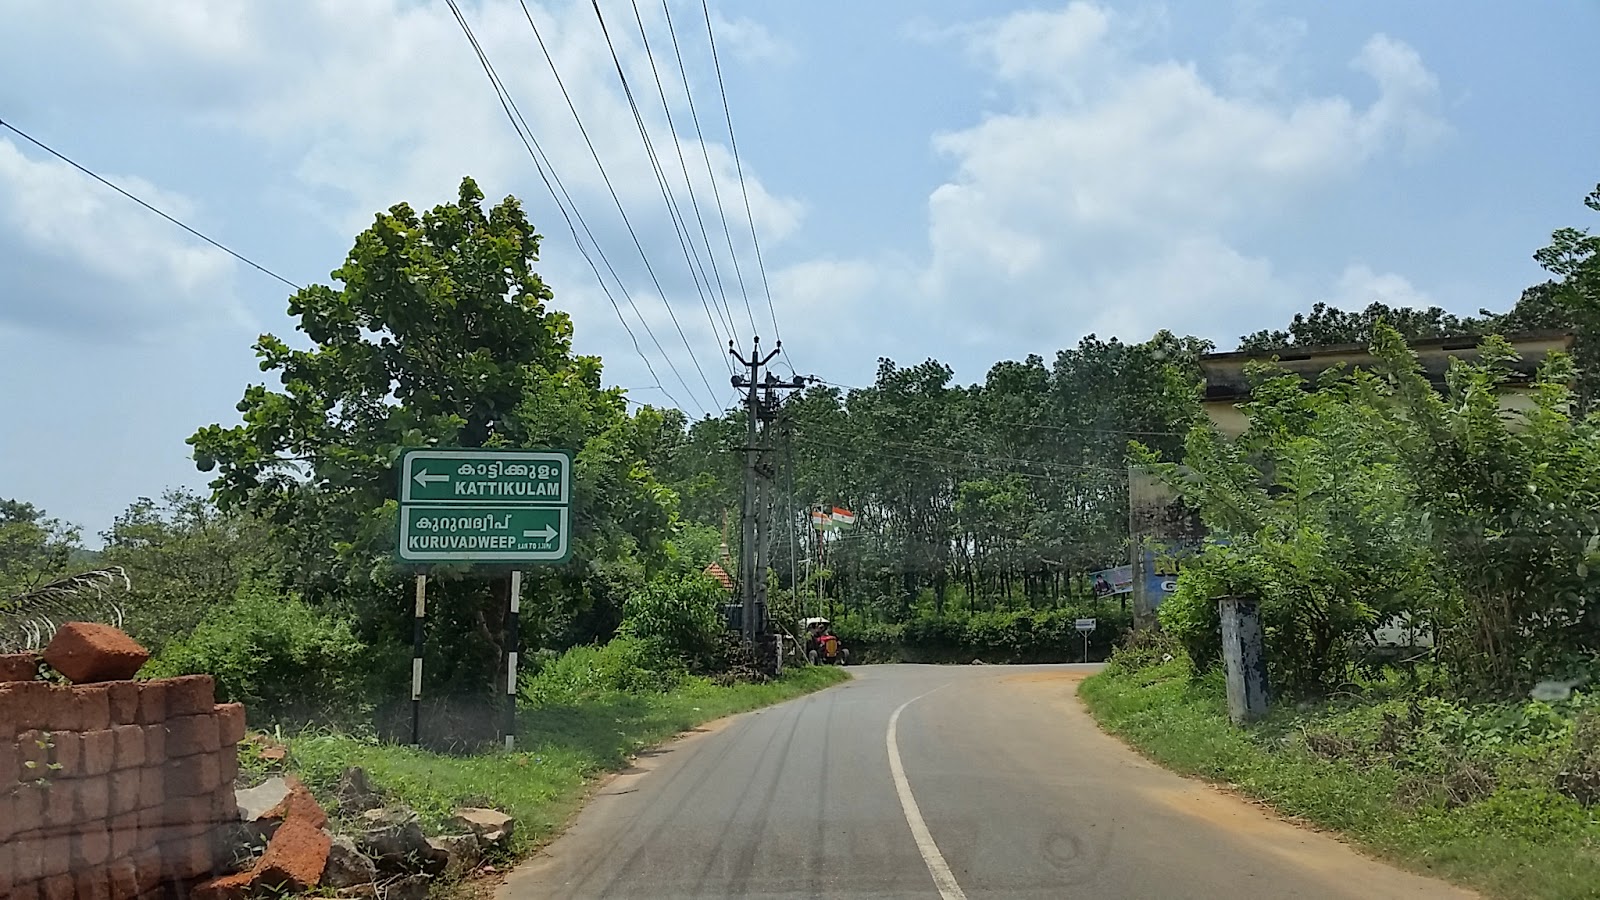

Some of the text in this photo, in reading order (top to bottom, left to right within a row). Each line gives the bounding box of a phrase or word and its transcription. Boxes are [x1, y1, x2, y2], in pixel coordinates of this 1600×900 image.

[457, 461, 559, 480] കാട്ടിക്കുളം
[455, 481, 560, 496] KATTIKULAM
[415, 514, 512, 532] കുറുവദ്വീപ്
[409, 535, 516, 549] KURUVADWEEP
